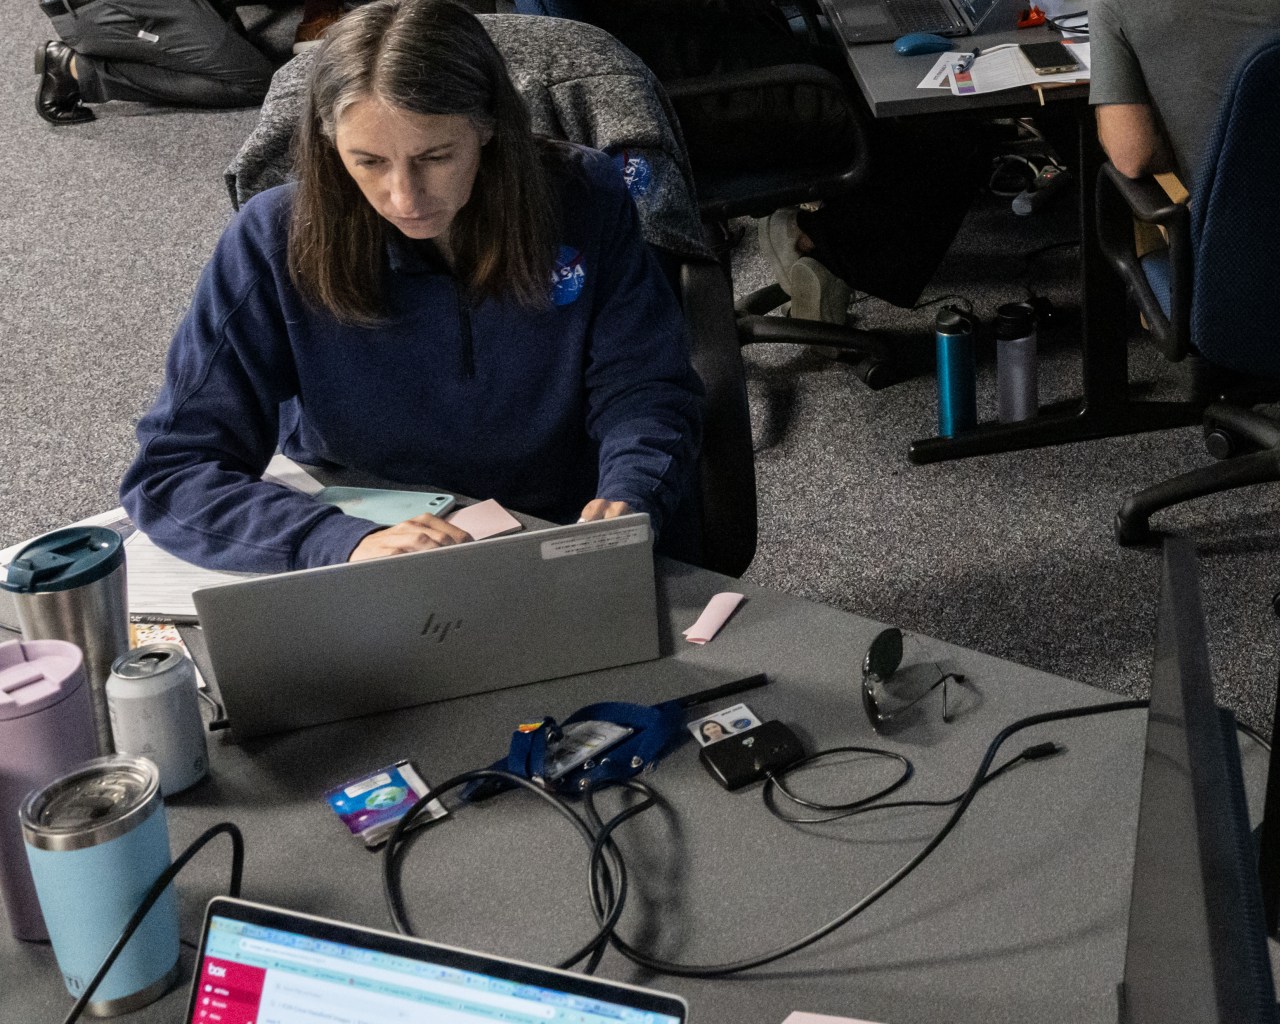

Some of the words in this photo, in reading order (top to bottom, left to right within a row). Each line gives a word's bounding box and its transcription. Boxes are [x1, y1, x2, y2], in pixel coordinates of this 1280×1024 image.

[624, 158, 641, 188] ASA
[550, 264, 584, 284] ASA
[207, 962, 227, 978] box
